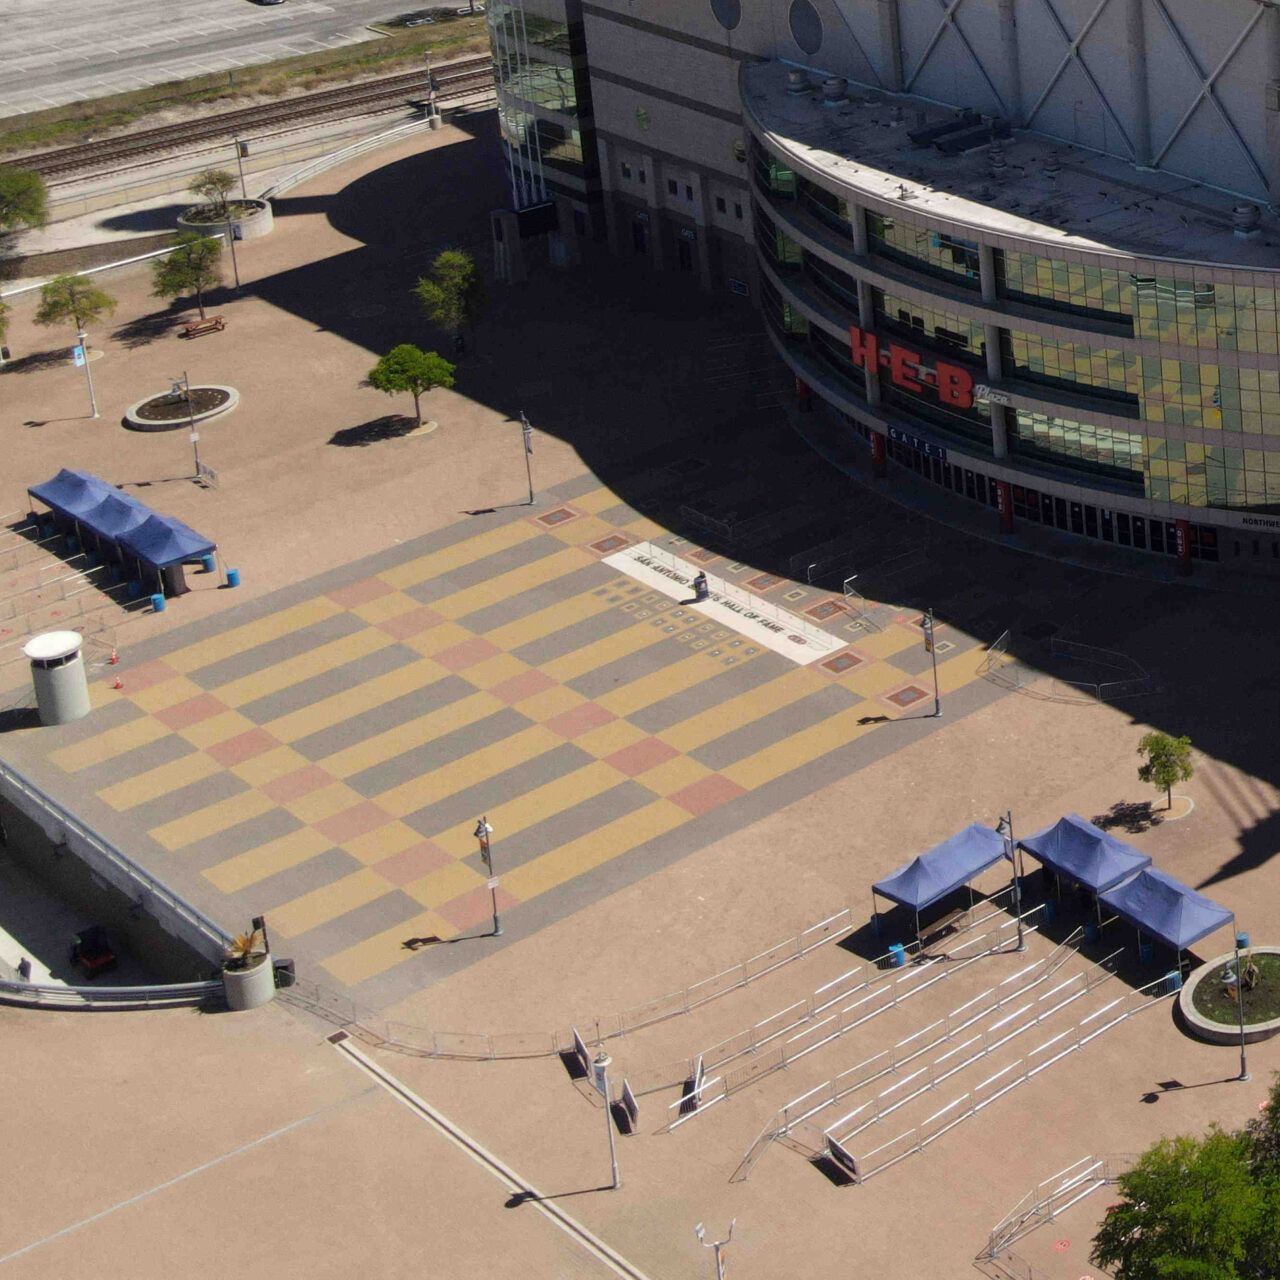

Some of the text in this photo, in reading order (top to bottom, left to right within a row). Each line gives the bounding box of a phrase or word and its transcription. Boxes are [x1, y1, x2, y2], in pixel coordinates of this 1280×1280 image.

[890, 428, 931, 453] GATE
[938, 448, 943, 459] 1
[721, 600, 743, 613] HALL
[743, 611, 760, 620] OF
[758, 619, 784, 633] FAME
